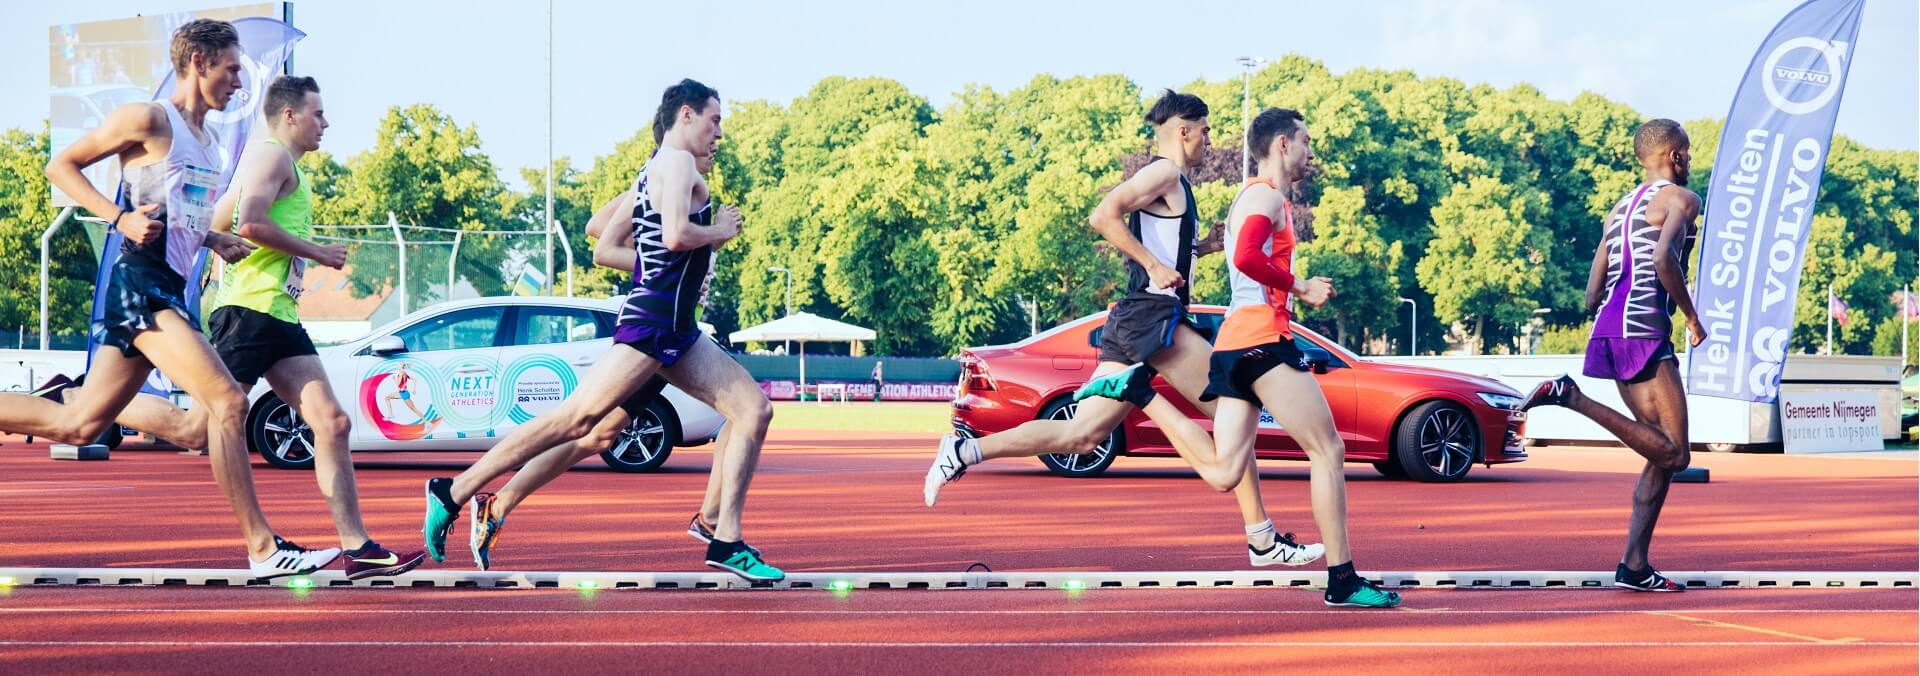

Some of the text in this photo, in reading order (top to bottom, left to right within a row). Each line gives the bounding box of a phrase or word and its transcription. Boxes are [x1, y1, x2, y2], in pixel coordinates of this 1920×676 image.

[1775, 67, 1829, 84] VOLVO
[1761, 137, 1821, 313] VOLVO
[1696, 128, 1769, 393] Henk Scholten
[451, 376, 493, 390] NEXT
[911, 385, 957, 398] ATHLETICS
[450, 390, 495, 398] GENERATION
[451, 397, 494, 406] ATHLETICS
[1785, 400, 1877, 422] Gemeente Nijmegen
[1787, 424, 1880, 446] partner in topsport
